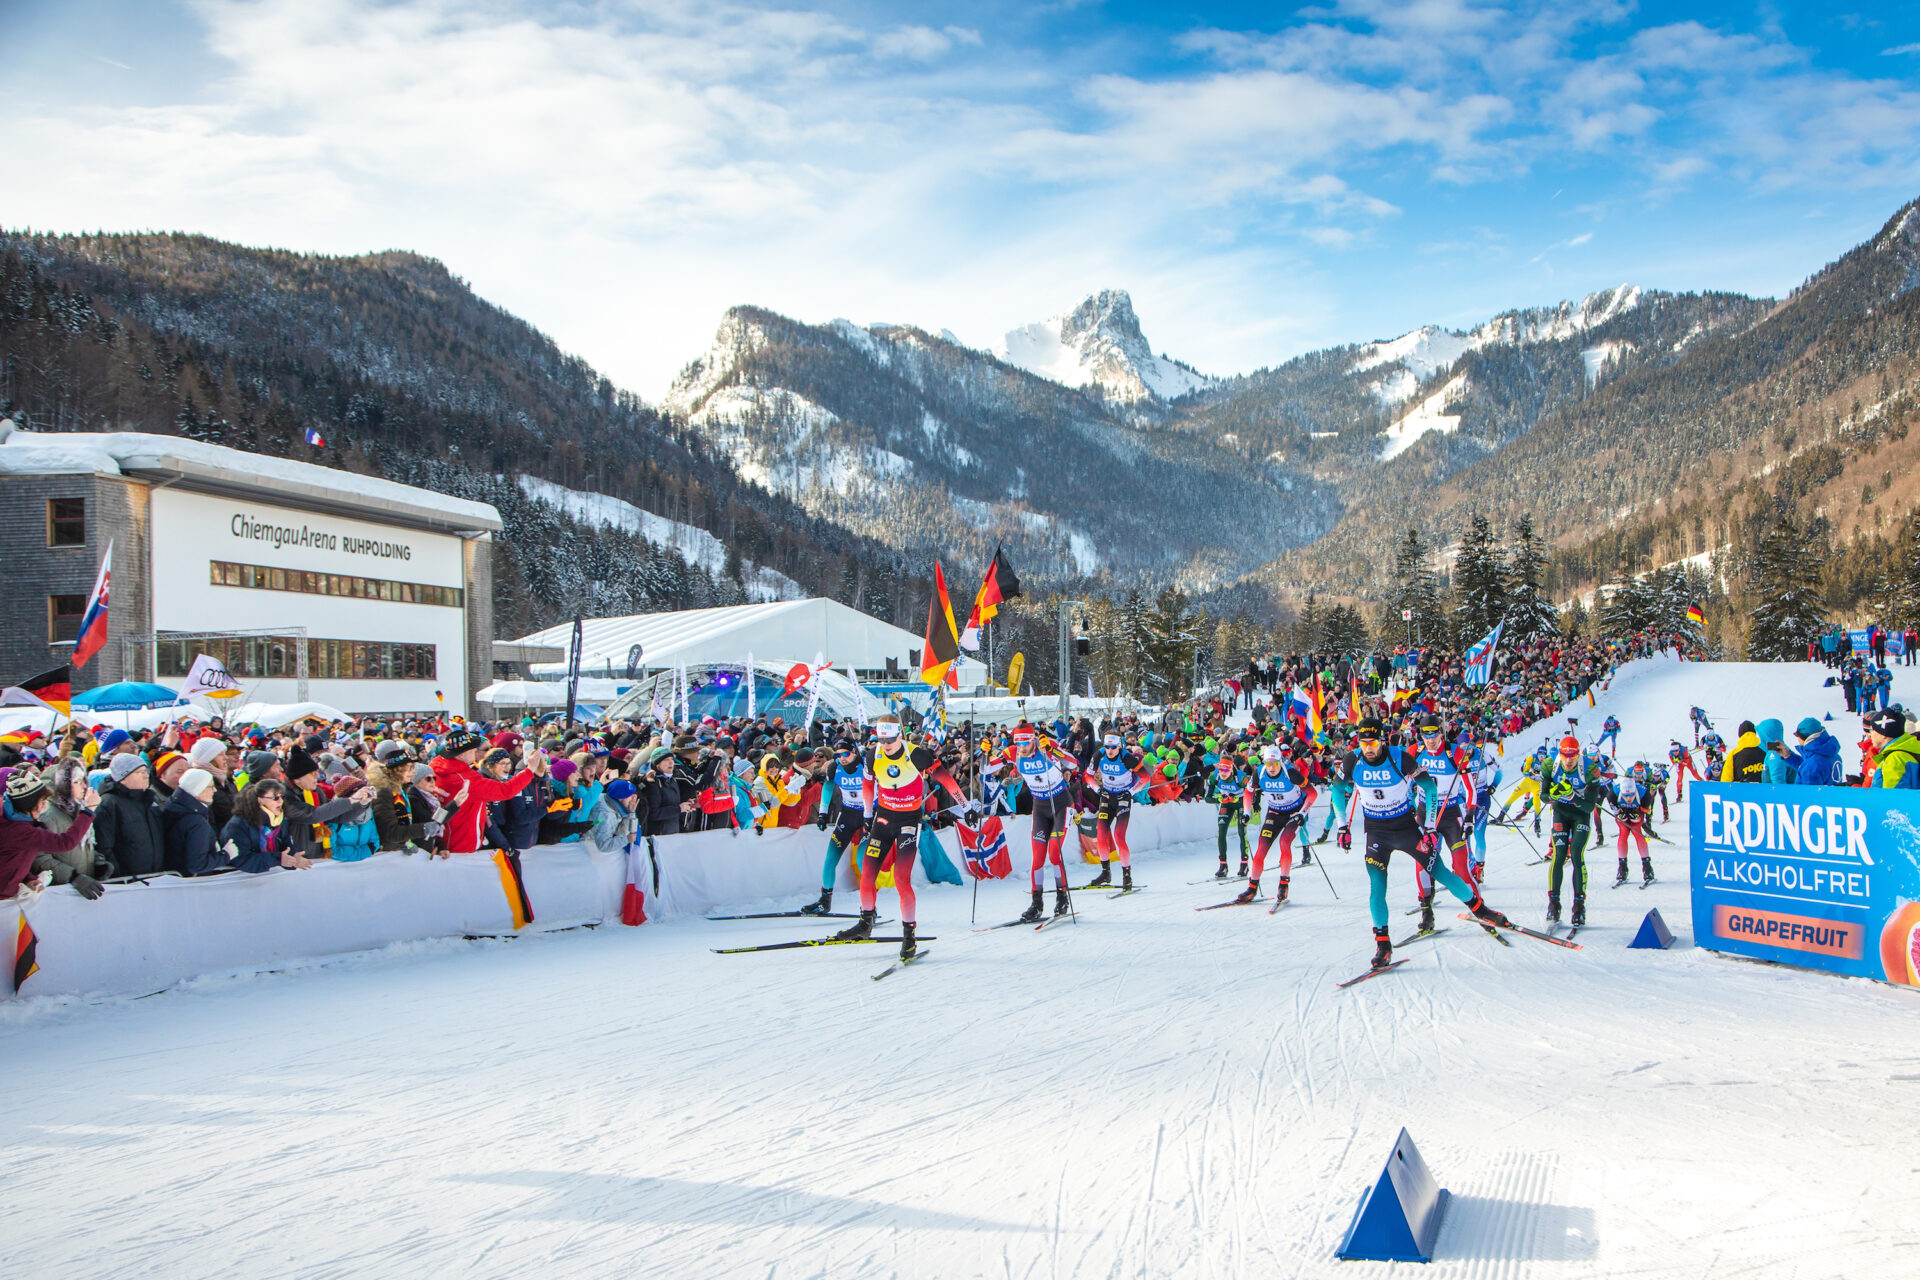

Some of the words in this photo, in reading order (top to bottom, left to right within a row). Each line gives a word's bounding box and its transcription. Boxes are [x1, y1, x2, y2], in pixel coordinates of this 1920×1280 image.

[342, 536, 411, 561] RUHPOLDING
[1023, 760, 1045, 770] DKB
[1103, 763, 1121, 772] DKB
[1422, 759, 1446, 769] DKB
[1363, 770, 1392, 781] DKB
[841, 776, 863, 786] DKB
[1265, 781, 1285, 789] DKB
[892, 784, 898, 792] 1
[1221, 783, 1237, 791] DKB
[1373, 789, 1384, 800] 3
[1703, 794, 1875, 866] ERDINGER
[1704, 858, 1870, 897] ALKOHOLFREI
[1728, 914, 1848, 948] GRAPEFRUIT
